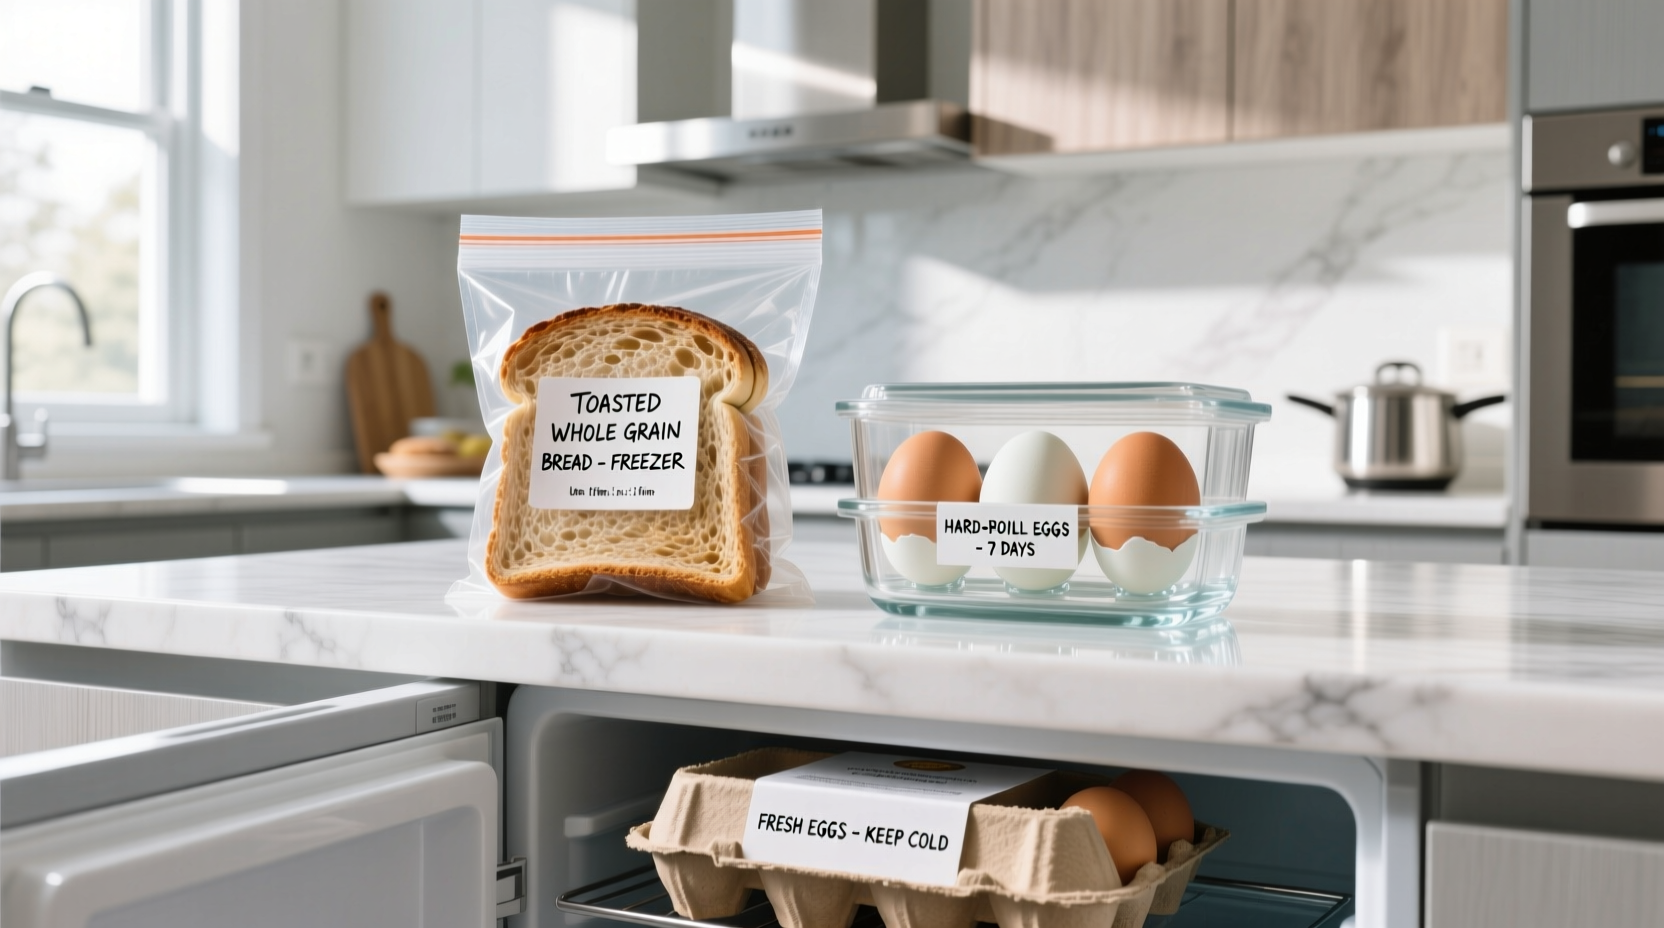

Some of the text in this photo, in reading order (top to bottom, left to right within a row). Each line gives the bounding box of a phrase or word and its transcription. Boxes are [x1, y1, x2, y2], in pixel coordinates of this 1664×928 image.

[570, 391, 662, 415] TOASTED
[551, 420, 681, 443] WHOLE GRAIN
[541, 452, 593, 471] BREAD
[610, 452, 685, 471] FREEZER
[1033, 521, 1070, 538] EGGS
[987, 541, 996, 556] 7
[1001, 541, 1035, 557] DAYS
[757, 812, 804, 834] FRESH
[807, 819, 847, 840] EGGS
[864, 825, 904, 847] KEEP
[907, 830, 949, 851] COLD
